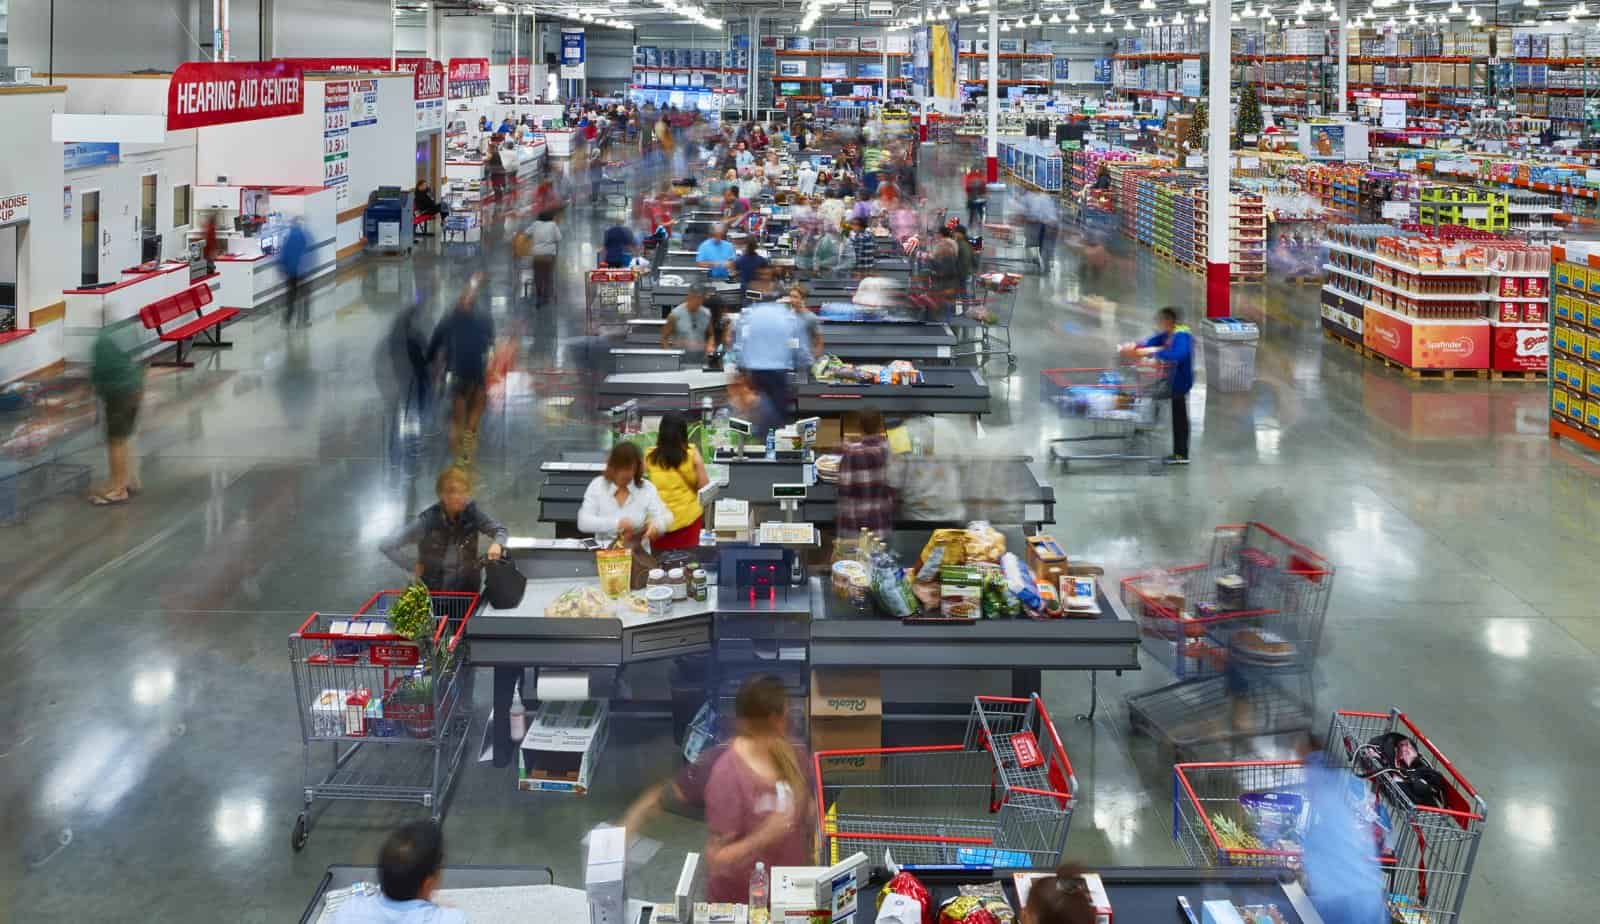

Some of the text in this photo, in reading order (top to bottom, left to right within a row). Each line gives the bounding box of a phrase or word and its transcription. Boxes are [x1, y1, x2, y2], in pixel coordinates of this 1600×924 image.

[177, 80, 236, 115] HEARING
[238, 79, 258, 109] AID
[261, 77, 299, 107] CENTER
[419, 73, 440, 96] EXAMS
[828, 698, 866, 711] Ricola
